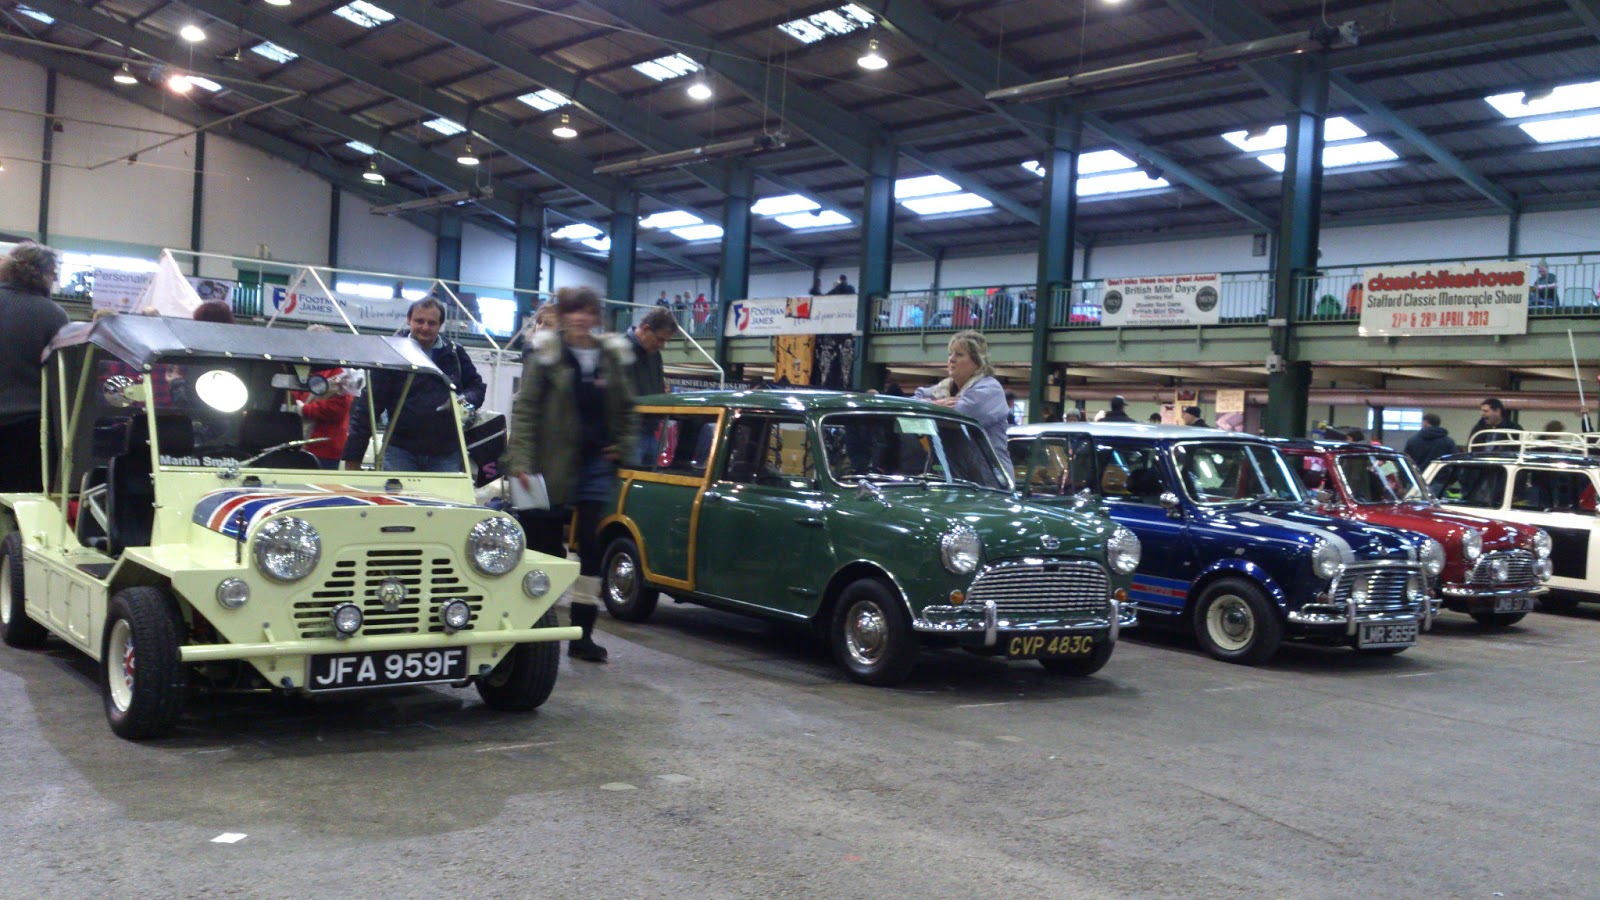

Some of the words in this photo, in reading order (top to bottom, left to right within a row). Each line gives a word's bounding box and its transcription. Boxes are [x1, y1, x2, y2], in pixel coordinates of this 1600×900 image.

[1368, 268, 1525, 291] classicbikeshows
[1125, 286, 1152, 295] British
[1154, 285, 1172, 293] Mini
[1175, 284, 1197, 295] Days
[1367, 293, 1402, 308] Stafford
[1404, 293, 1437, 307] Classic
[1439, 291, 1492, 308] Motorcycle
[1495, 290, 1522, 304] Show
[750, 307, 785, 316] FOOTMAN
[1440, 311, 1464, 327] APRIL
[1468, 311, 1489, 326] 2013
[160, 454, 200, 466] Martin
[203, 456, 240, 467] Smith
[1009, 636, 1045, 656] CVP
[1047, 635, 1093, 654] 483C
[316, 655, 377, 685] JFA
[384, 650, 462, 680] 959F
